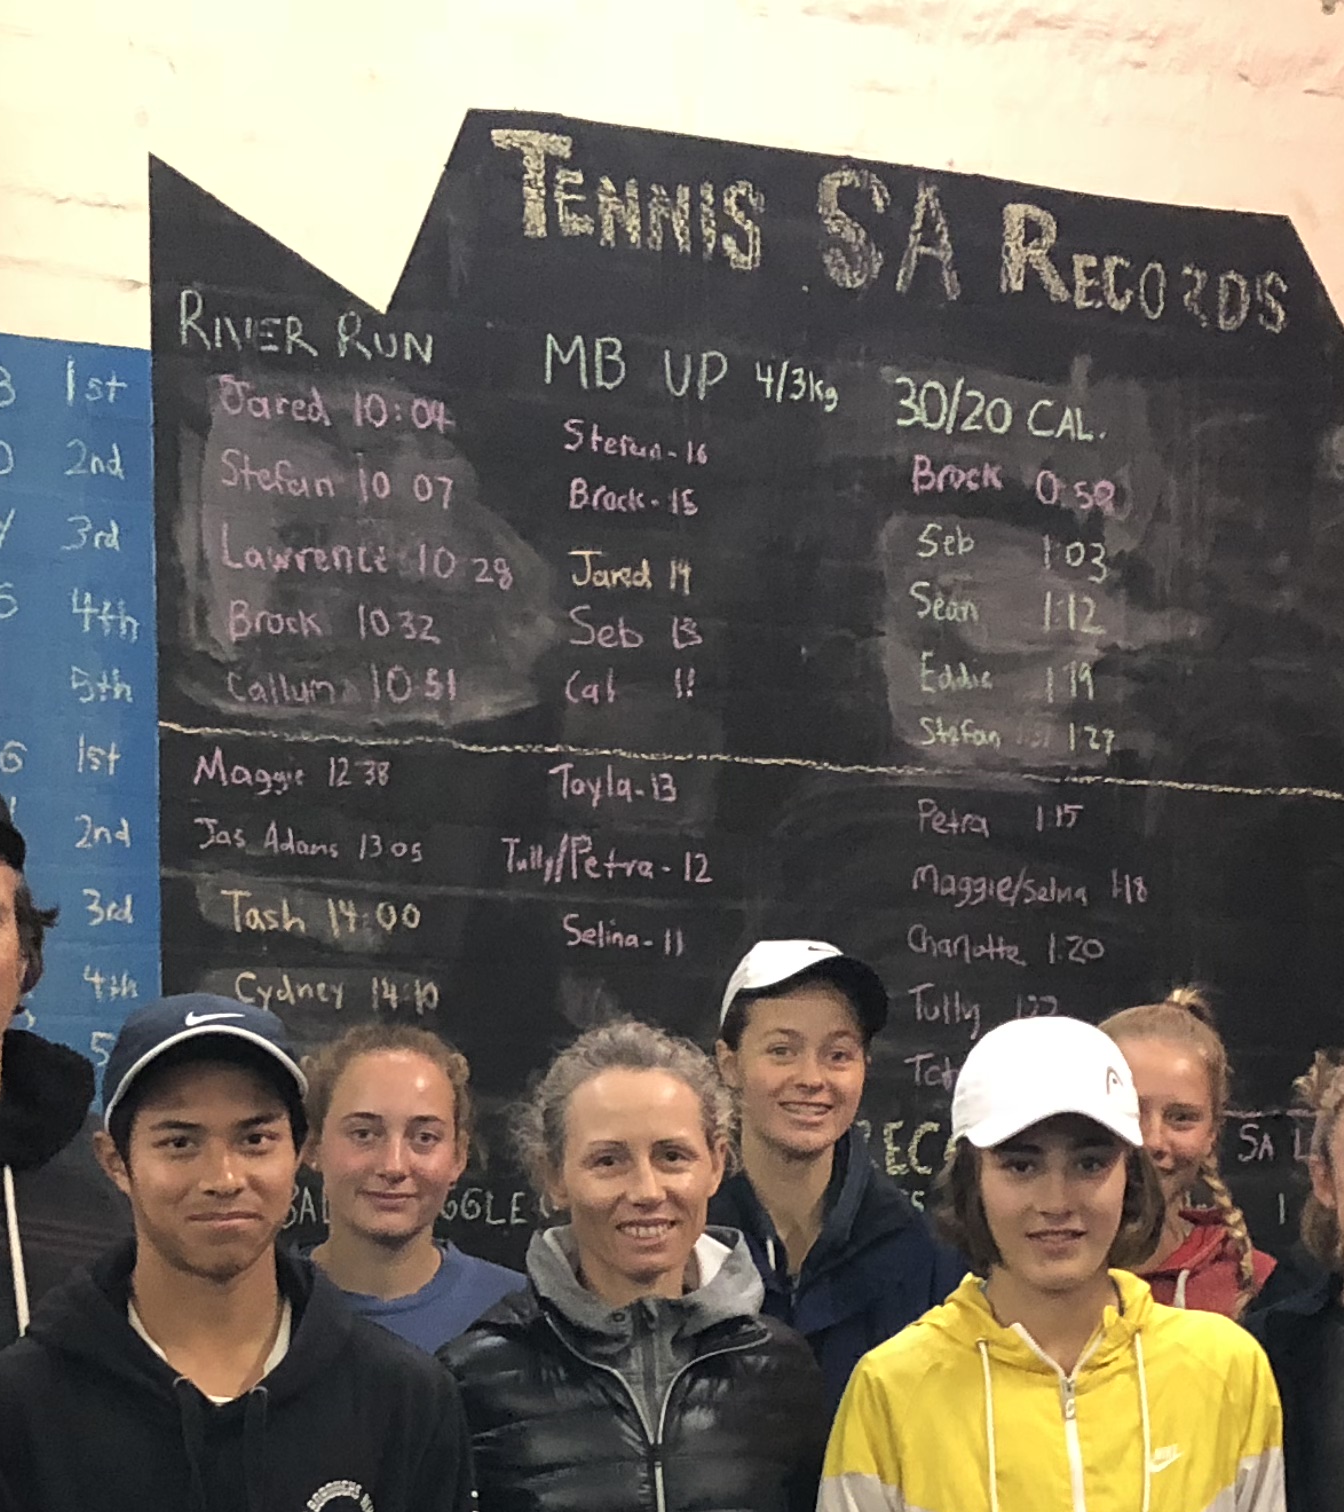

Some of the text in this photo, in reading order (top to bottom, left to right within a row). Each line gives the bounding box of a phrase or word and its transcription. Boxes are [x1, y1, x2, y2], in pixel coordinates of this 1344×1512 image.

[818, 163, 961, 302] SA
[179, 290, 433, 364] RIVER RUN
[65, 356, 127, 406] 1st
[544, 332, 626, 390] MB
[664, 350, 728, 400] UP
[218, 374, 332, 426] Jared
[895, 376, 1013, 435] 30/20
[65, 440, 124, 481] 2nd
[221, 448, 335, 498] Stefan
[61, 515, 120, 553] 3rd
[917, 522, 975, 558] Seb
[568, 550, 652, 590] Jared
[71, 588, 141, 643] 4th
[569, 604, 643, 648] Seb
[71, 666, 135, 703] 5th
[76, 732, 122, 776] 1st
[75, 813, 131, 850] 2nd
[83, 887, 133, 927] 3rd
[221, 888, 305, 934] Tash
[83, 964, 141, 1000] 4th
